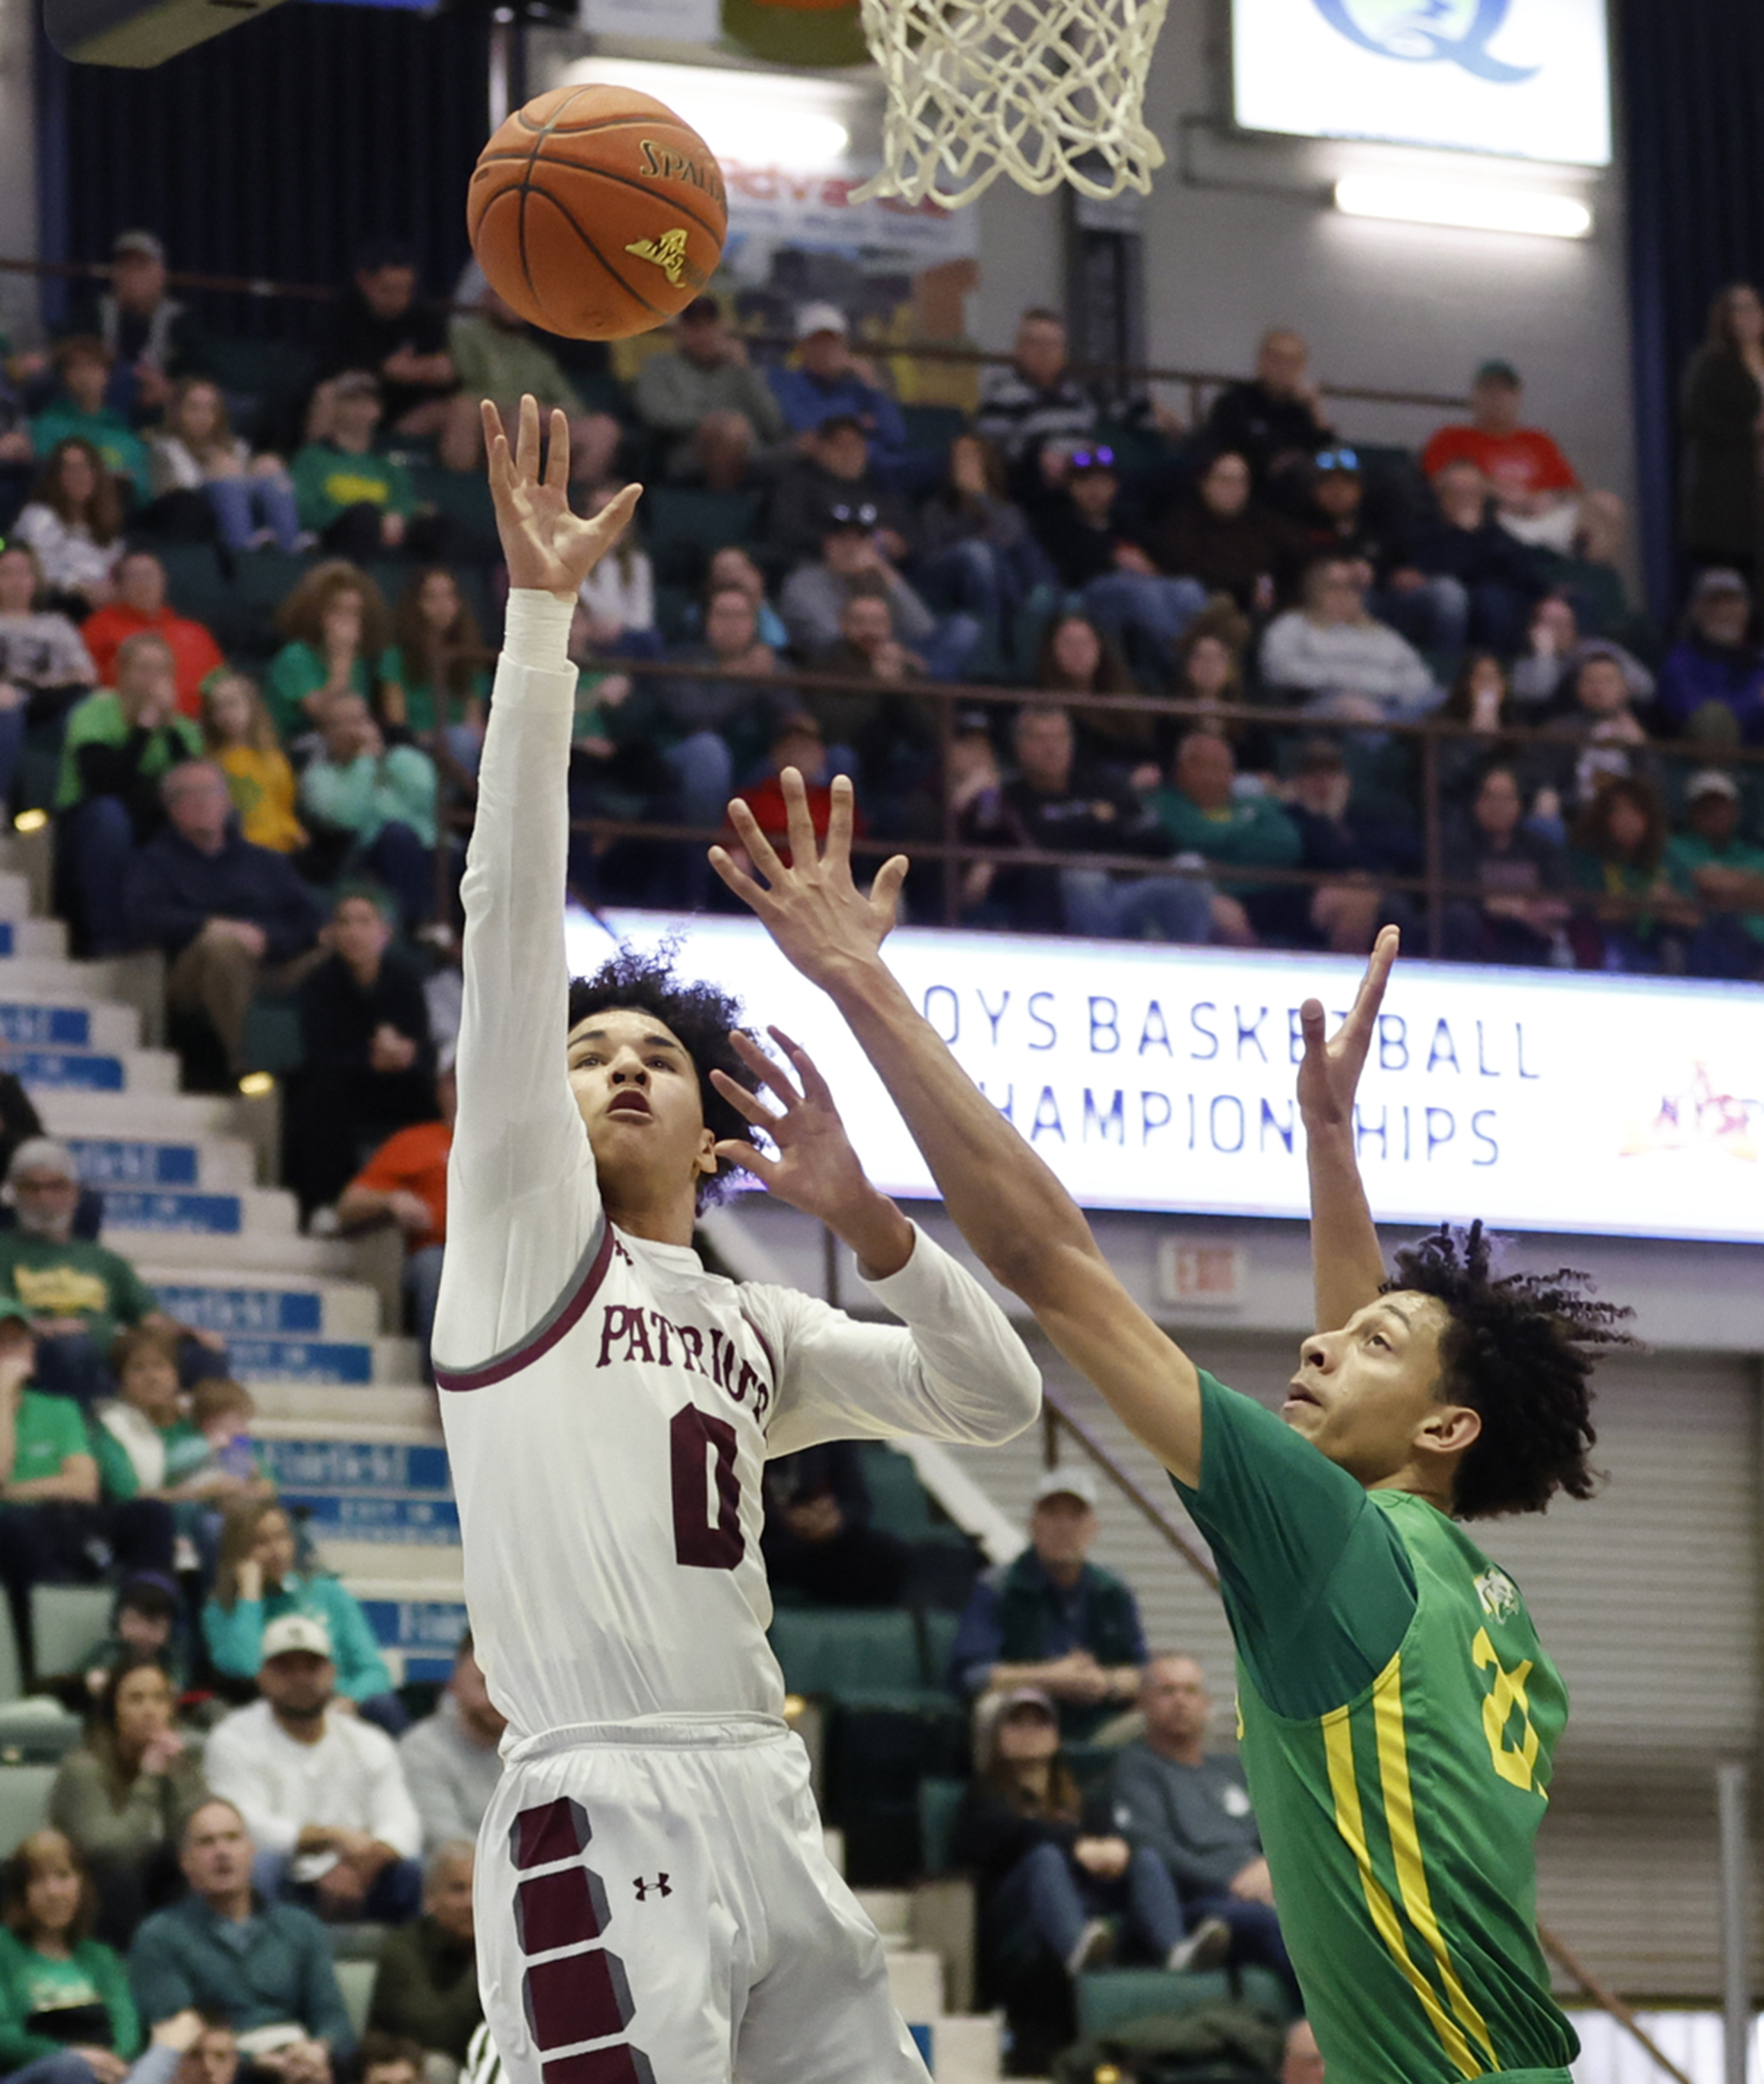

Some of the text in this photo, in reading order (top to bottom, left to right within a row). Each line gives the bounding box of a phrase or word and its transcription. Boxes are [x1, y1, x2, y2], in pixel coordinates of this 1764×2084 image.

[924, 984, 1540, 1080] OYS BASKEBALL
[979, 1082, 1499, 1166] HAMPIONHIPS
[670, 1401, 746, 1571] 0
